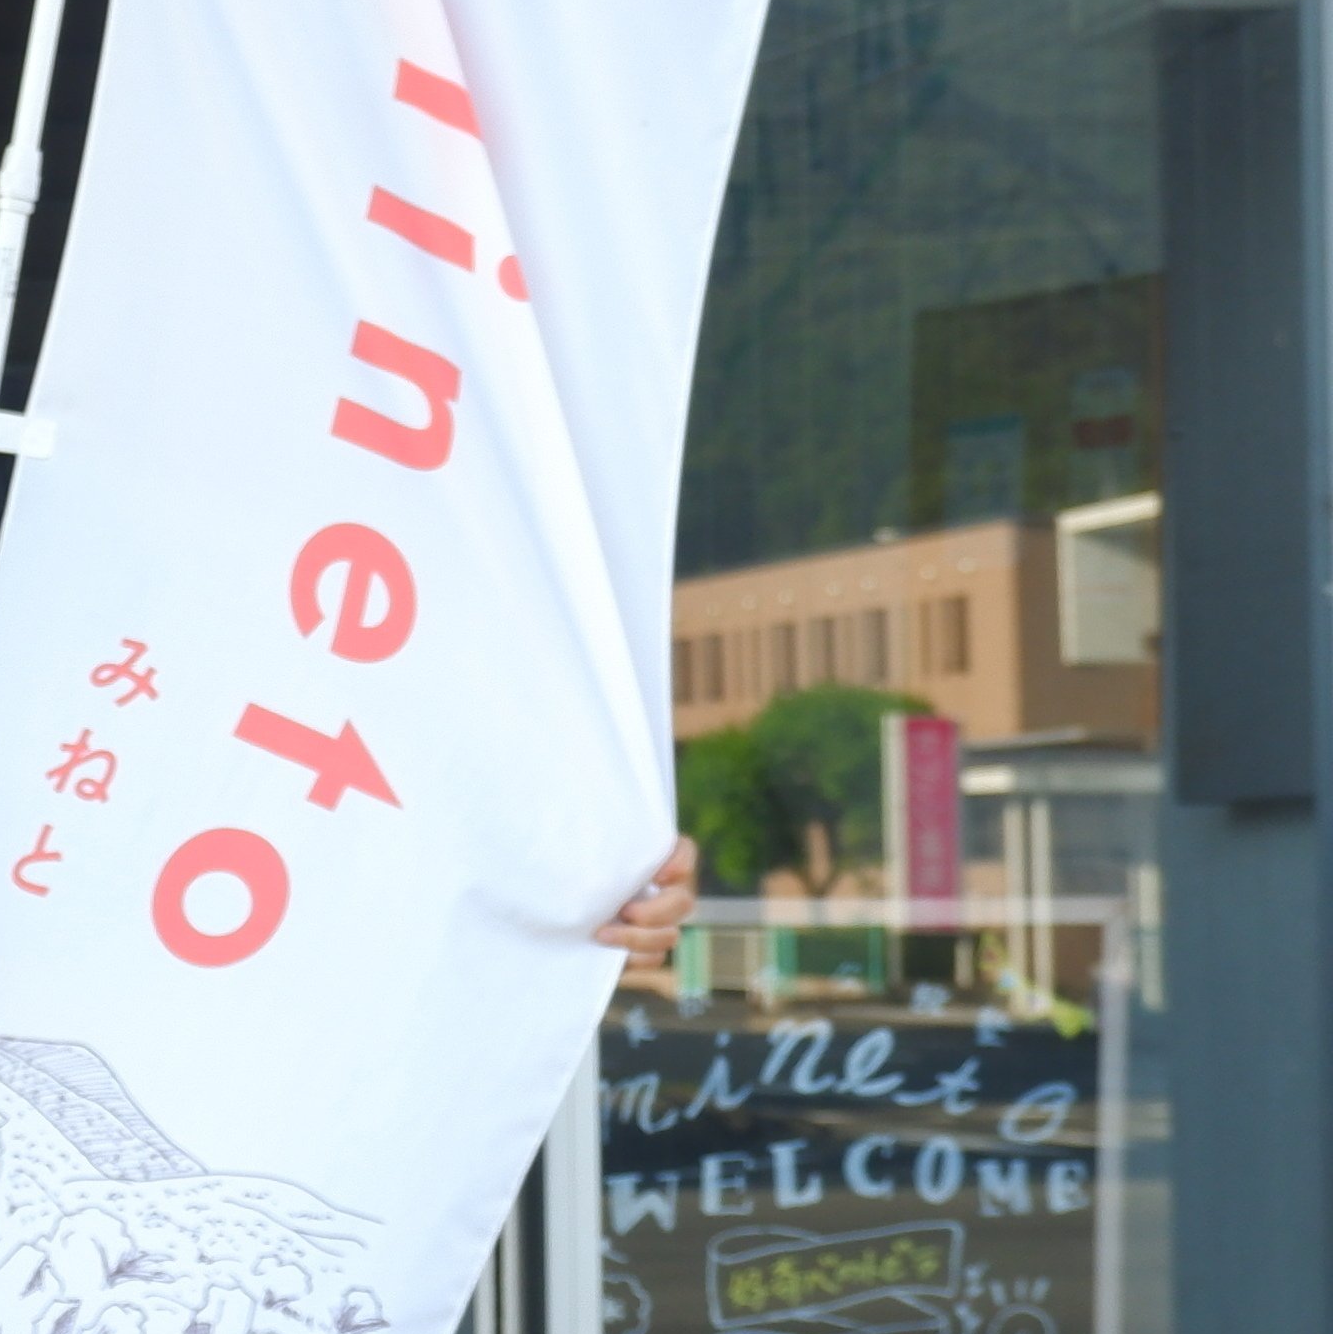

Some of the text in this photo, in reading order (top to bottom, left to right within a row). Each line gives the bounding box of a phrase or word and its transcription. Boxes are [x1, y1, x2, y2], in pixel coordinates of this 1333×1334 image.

[151, 57, 530, 969] ineto
[11, 637, 159, 899] みねと
[607, 1133, 1091, 1234] WELCOME
